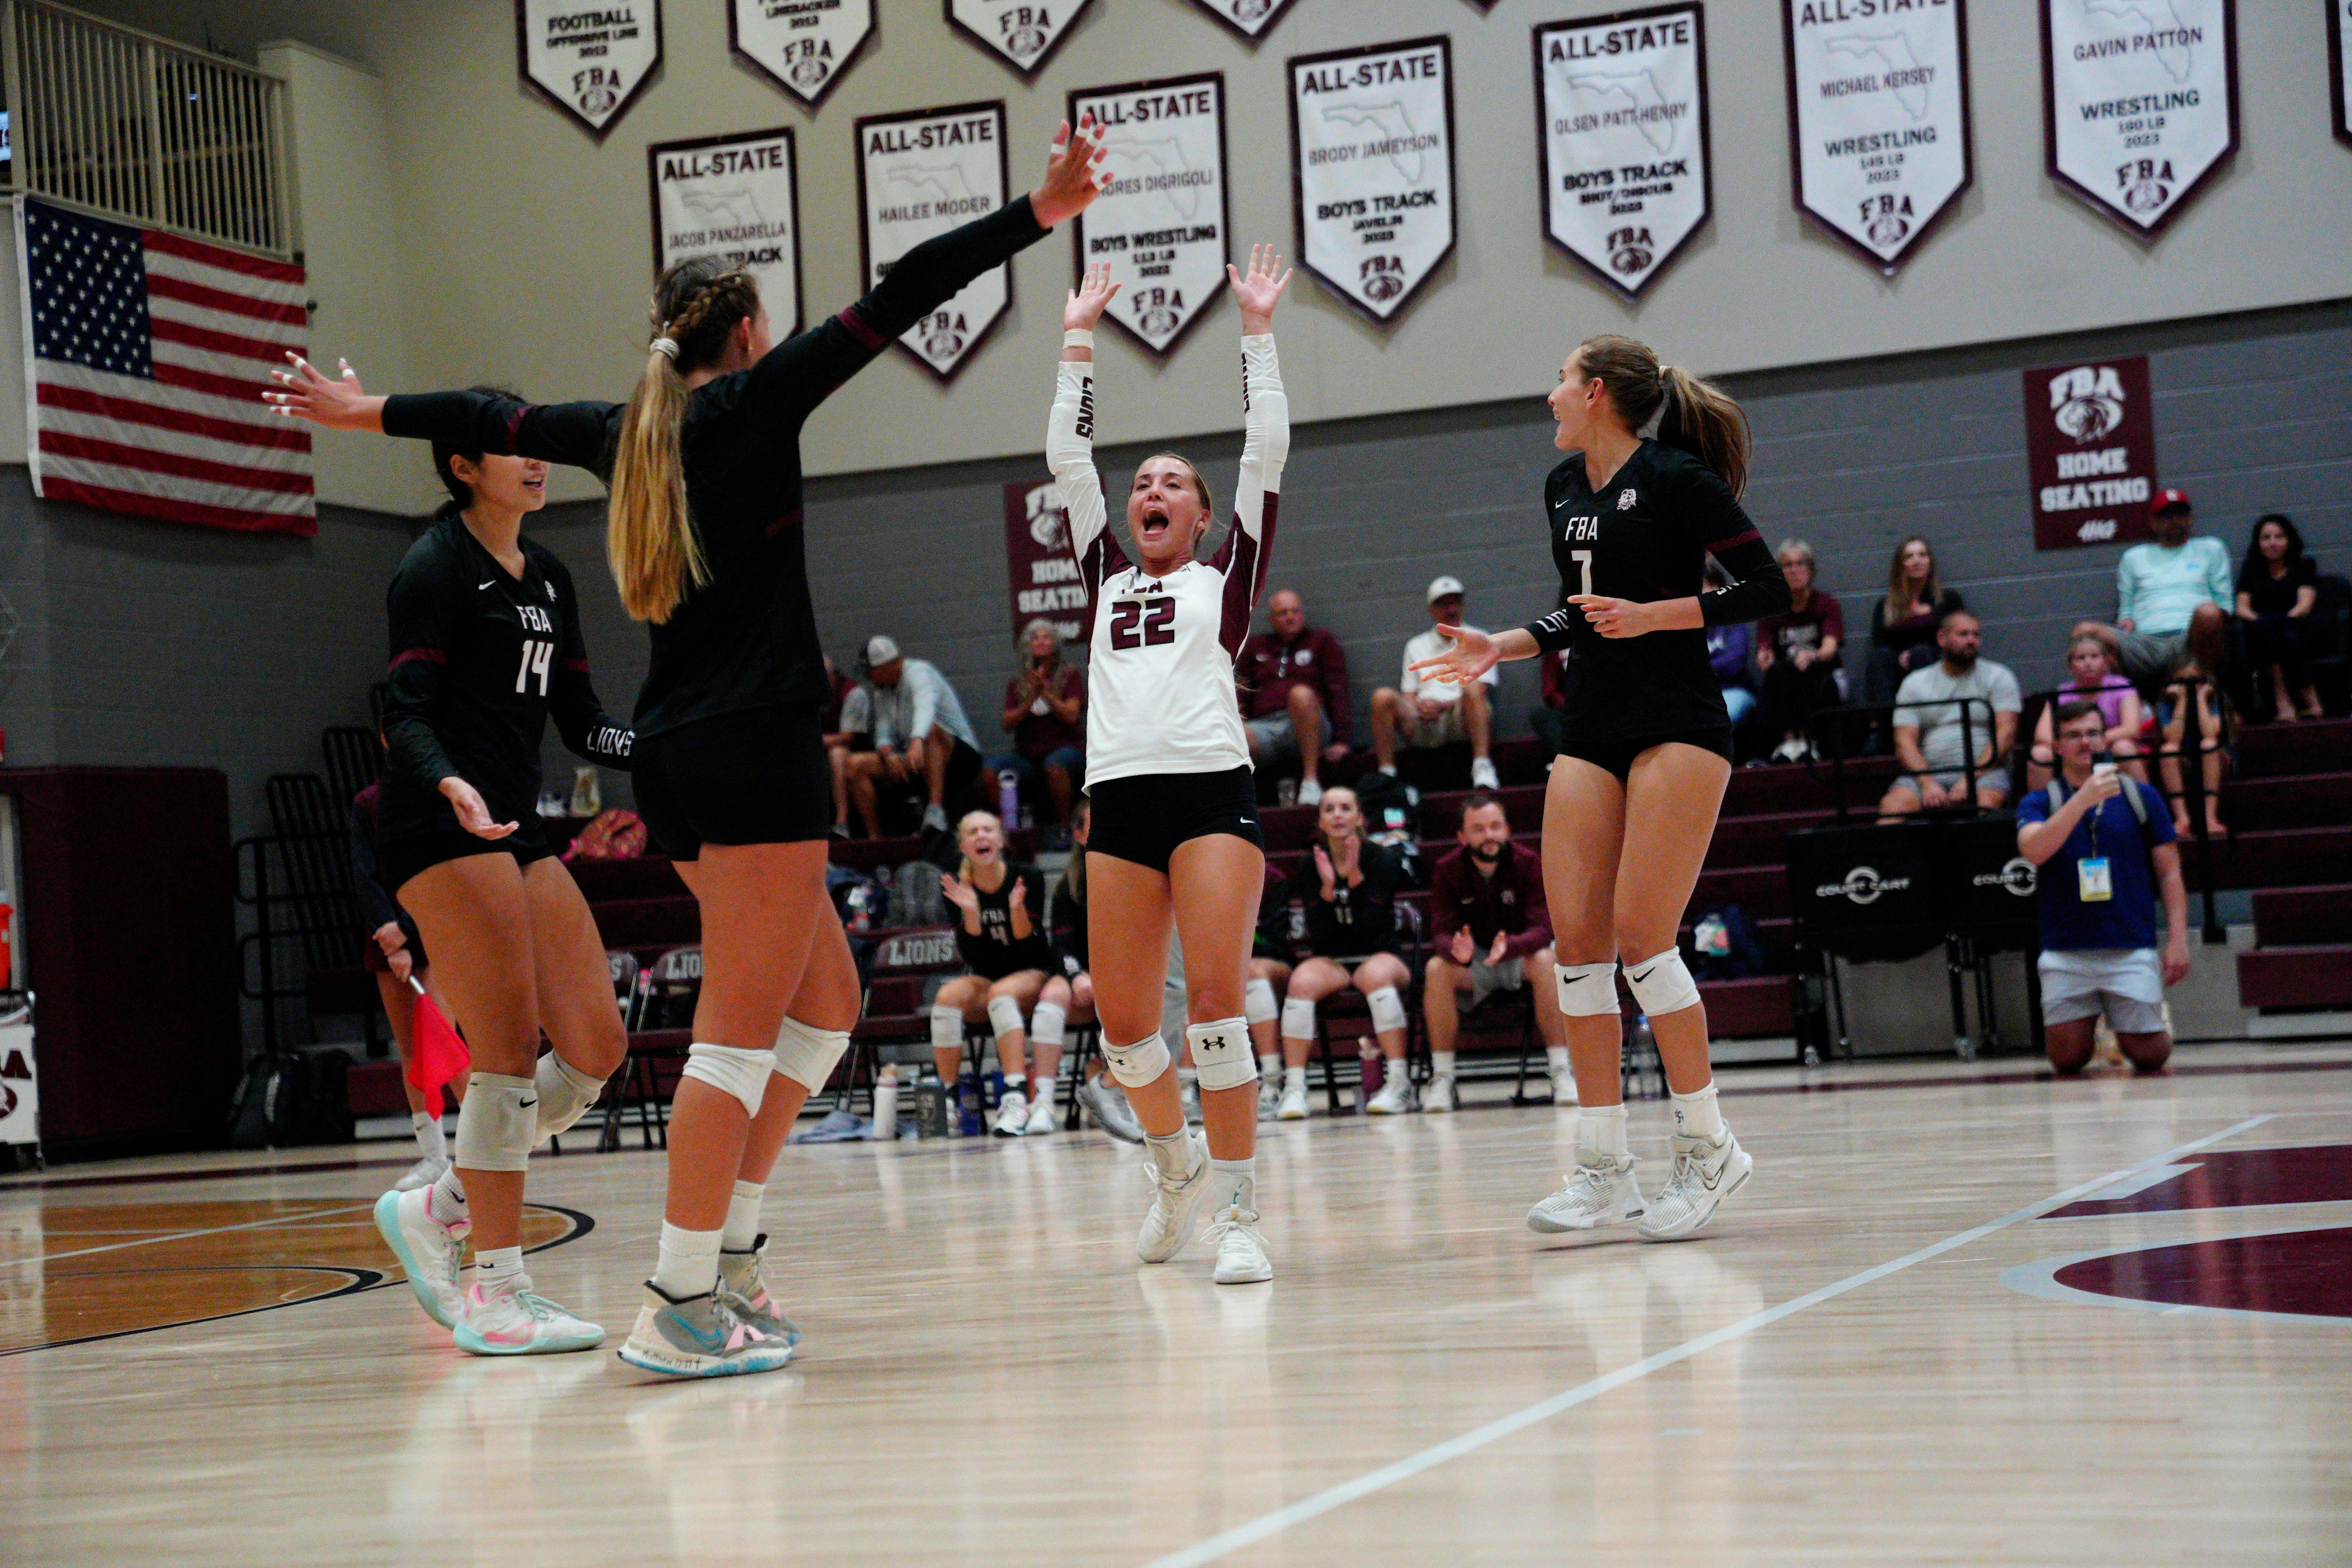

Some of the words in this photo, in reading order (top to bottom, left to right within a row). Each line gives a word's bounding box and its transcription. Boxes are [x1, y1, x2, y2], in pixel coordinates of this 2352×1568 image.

[548, 8, 635, 32] FOOTBALL
[999, 8, 1049, 34] FBA
[784, 39, 832, 65] FBA
[1548, 20, 1689, 64] ALL-STATE
[2074, 36, 2127, 61] GAVIN
[2132, 27, 2202, 52] PATTON
[573, 68, 620, 94] FBA
[1302, 54, 1437, 95] ALL-STATE
[1820, 75, 1878, 98] MICHAEL
[1883, 65, 1935, 88] KERSEY
[1080, 91, 1210, 125] ALL-STATE
[2080, 89, 2200, 120] WRESTLING
[870, 119, 993, 155] ALL-STATE
[1825, 127, 1937, 157] WRESTLING
[664, 145, 782, 182] ALL-STATE
[1309, 145, 1357, 166] BRODY
[1564, 170, 1614, 190] BOYS
[1621, 159, 1687, 181] TRACK
[2116, 159, 2175, 188] FBA
[879, 202, 931, 224] HAILEE
[1317, 200, 1367, 220] BOYS
[1373, 190, 1437, 212] TRACK
[1858, 195, 1914, 223] FBA
[1091, 235, 1128, 253] BOYS
[1131, 289, 1184, 314] FBA
[2057, 447, 2128, 479] HOME
[2041, 476, 2151, 512] SEATING
[1565, 516, 1598, 541] FBA
[1031, 557, 1080, 584] HOM
[1571, 550, 1593, 595] 7
[516, 606, 553, 633] FBA
[1110, 596, 1175, 650] 22
[516, 640, 554, 697] 14
[665, 952, 701, 980] LIO
[888, 938, 954, 966] LIONS
